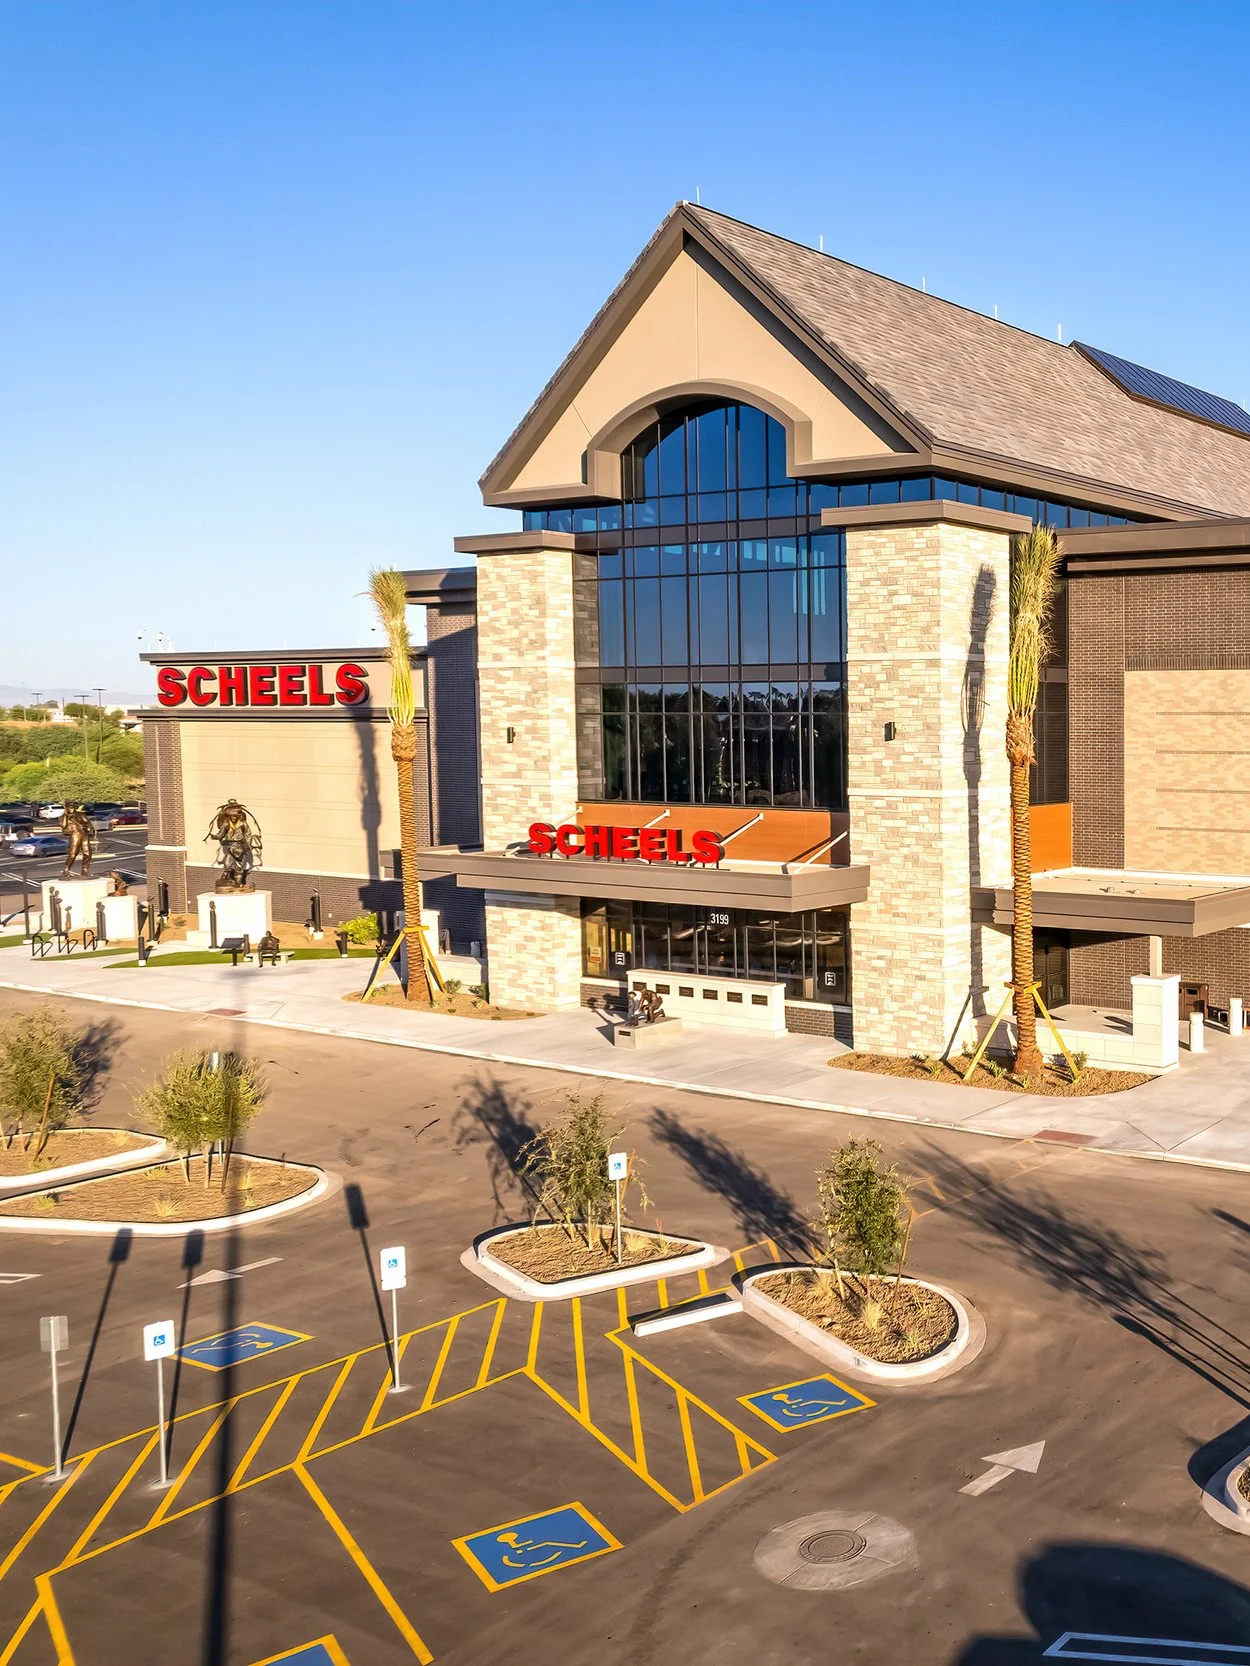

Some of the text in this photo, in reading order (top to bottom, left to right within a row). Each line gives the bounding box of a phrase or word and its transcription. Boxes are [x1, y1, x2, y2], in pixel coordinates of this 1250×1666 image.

[157, 663, 370, 707] SCHEELS
[529, 822, 726, 864] SCHEELS
[710, 913, 729, 925] 3199
